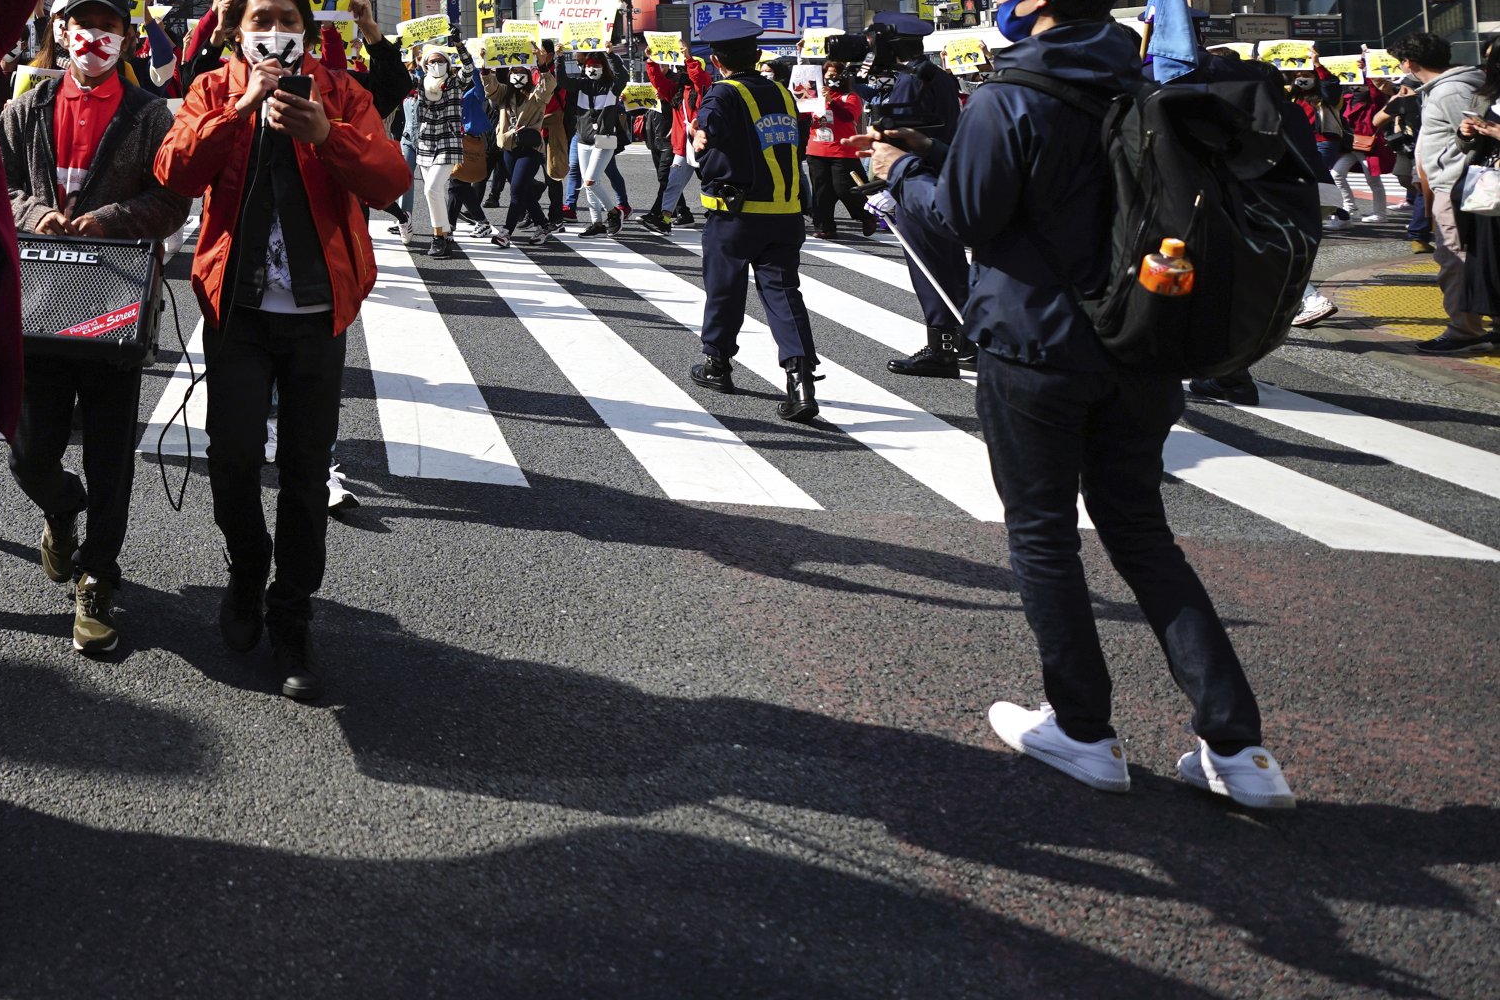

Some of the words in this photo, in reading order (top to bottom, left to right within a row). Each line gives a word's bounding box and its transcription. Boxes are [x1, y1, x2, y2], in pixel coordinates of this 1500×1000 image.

[559, 8, 602, 18] ACCEPT
[688, 1, 829, 32] 盛堂書店
[756, 115, 798, 132] POLICE
[764, 131, 795, 143] 警視庁
[20, 249, 99, 264] CUBE
[69, 319, 98, 335] Roland
[82, 323, 106, 335] CUBE
[106, 307, 137, 326] Street
